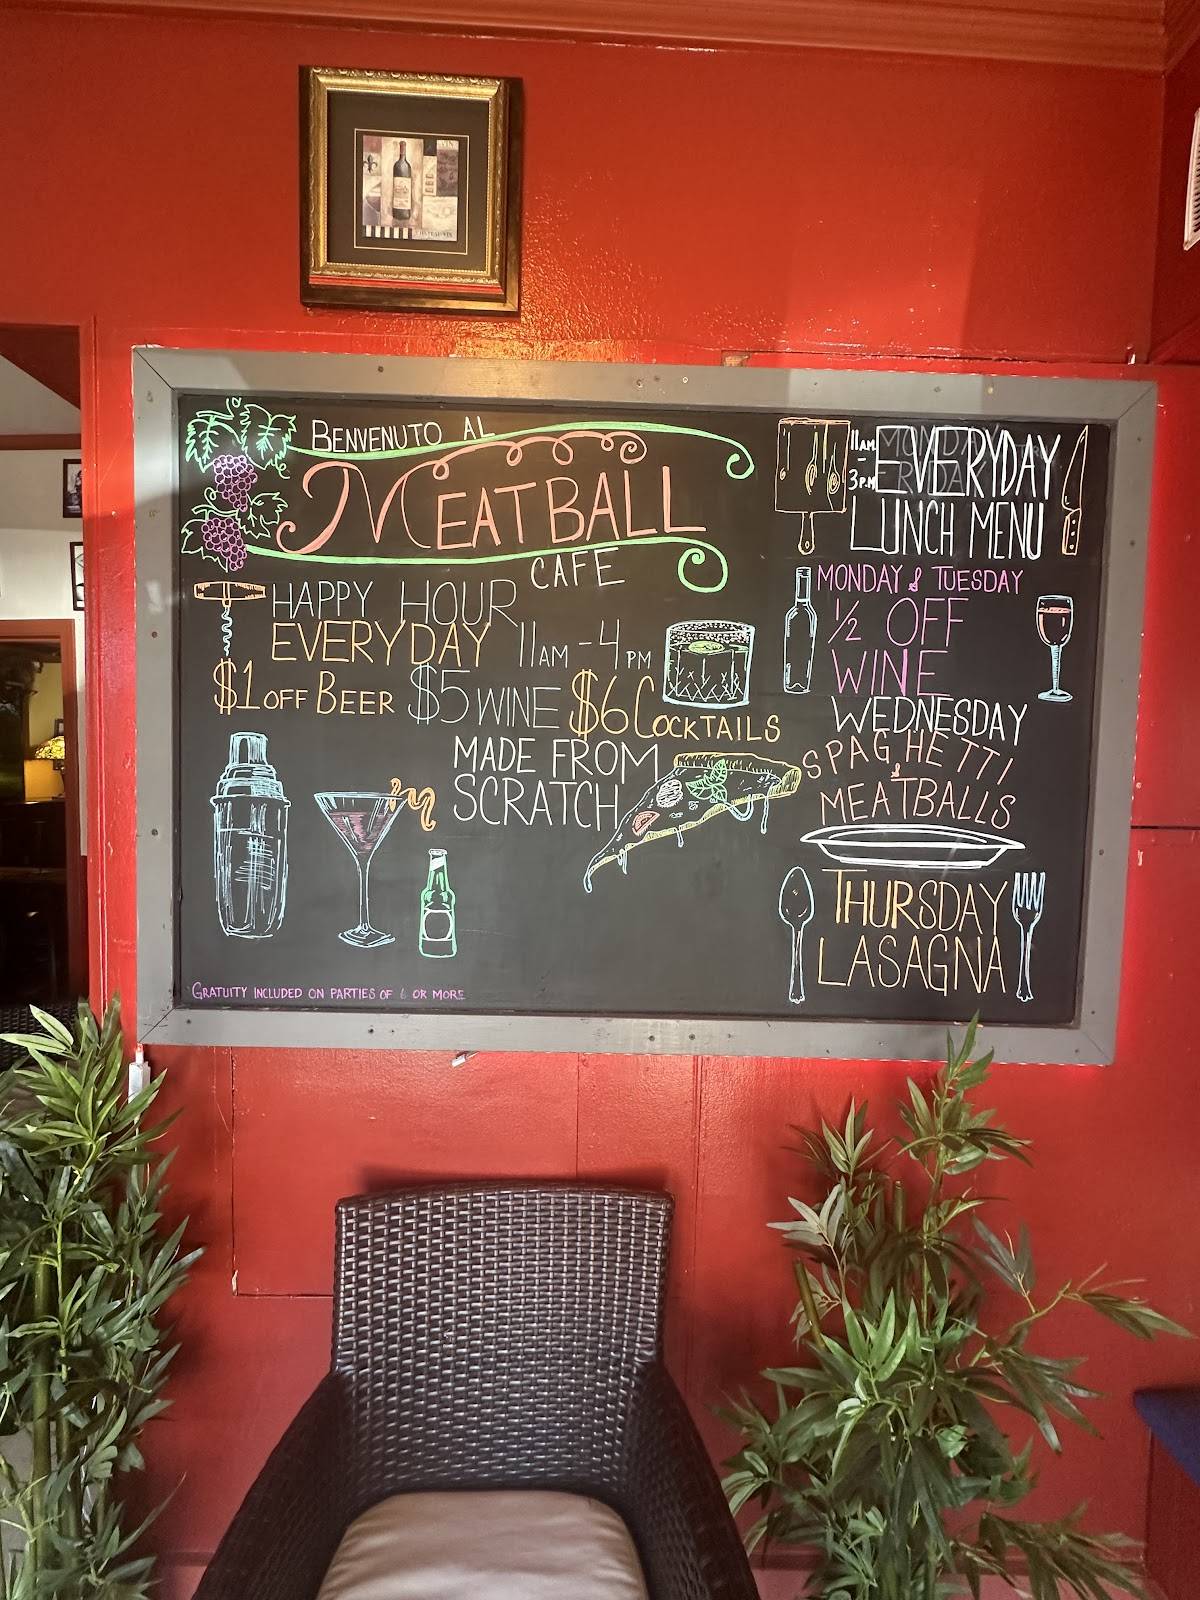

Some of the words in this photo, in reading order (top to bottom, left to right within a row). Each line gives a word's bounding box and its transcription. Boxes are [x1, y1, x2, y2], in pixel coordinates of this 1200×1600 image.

[312, 420, 442, 452] BENVENUTO
[464, 416, 495, 439] AL
[875, 425, 1062, 500] EVERYDAY
[276, 461, 706, 555] MEATBALL
[850, 495, 954, 557] LUNCH
[969, 501, 1044, 560] MENU
[530, 547, 625, 589] CAFE
[817, 564, 903, 593] MONDAY
[931, 566, 1024, 595] TUESDAY
[272, 580, 373, 619] HAPPY
[400, 579, 518, 627] HOUR
[886, 597, 969, 647] OFF
[271, 619, 491, 668] EVERYDAY
[831, 648, 950, 696] WINE
[212, 658, 260, 715] $1
[263, 689, 308, 710] OFF
[316, 670, 395, 715] BEER
[407, 663, 470, 724] $5
[477, 685, 561, 730] WINE
[634, 674, 781, 743] COCKTAILS
[831, 695, 1028, 746] WEDNESDAY
[453, 735, 536, 773] MADE
[553, 739, 659, 785] FROM
[802, 728, 1014, 785] SPAGHETTI
[453, 773, 619, 831] SCRATCH
[820, 777, 1017, 829] MEATBALLS
[821, 868, 1008, 935] THURSDAY
[191, 981, 248, 1000] GRATUITY
[253, 986, 303, 999] INCLUDED
[308, 987, 324, 1000] ON
[330, 987, 376, 1000] PARTIES
[379, 988, 393, 1000] OF
[412, 988, 428, 1000] OR
[432, 988, 465, 1001] MORE
[817, 934, 1006, 997] LASAGNA
